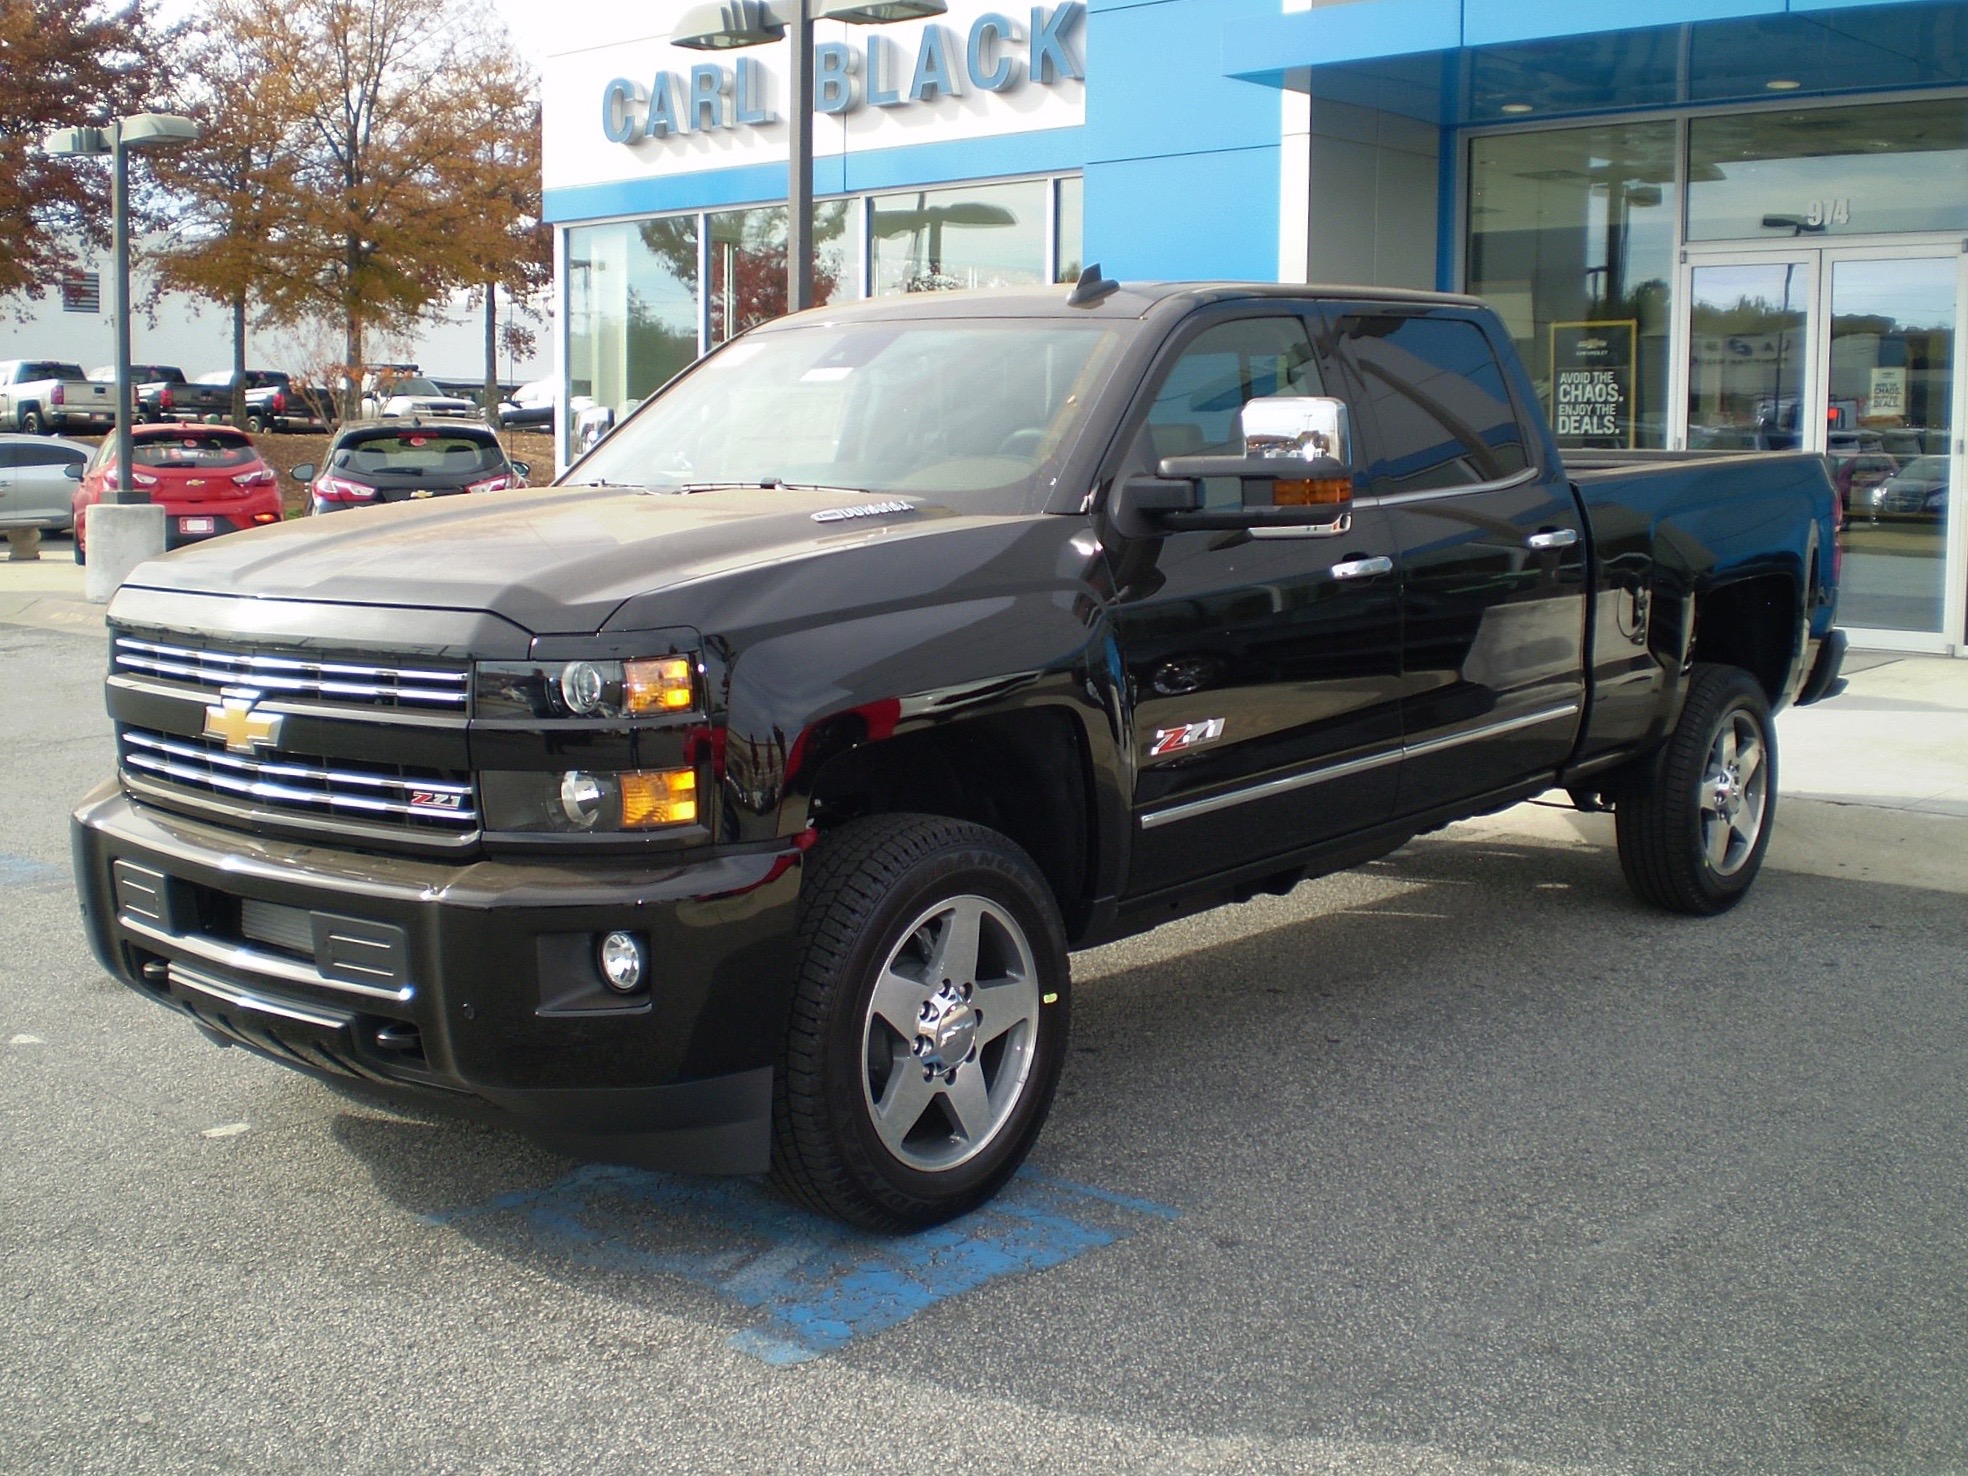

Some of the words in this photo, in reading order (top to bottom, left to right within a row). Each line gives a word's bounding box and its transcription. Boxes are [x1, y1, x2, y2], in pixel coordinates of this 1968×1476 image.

[603, 56, 776, 144] CARL
[814, 1, 1086, 113] BLACK
[1807, 199, 1850, 226] 974
[1560, 372, 1591, 384] AVOID
[1592, 371, 1615, 384] THE
[1560, 383, 1624, 402] CHAOS.
[1558, 404, 1594, 416] ENJOY
[1595, 404, 1617, 415] THE
[1557, 416, 1620, 435] DEALS.
[1150, 717, 1226, 755] Z71
[410, 791, 461, 810] Z71
